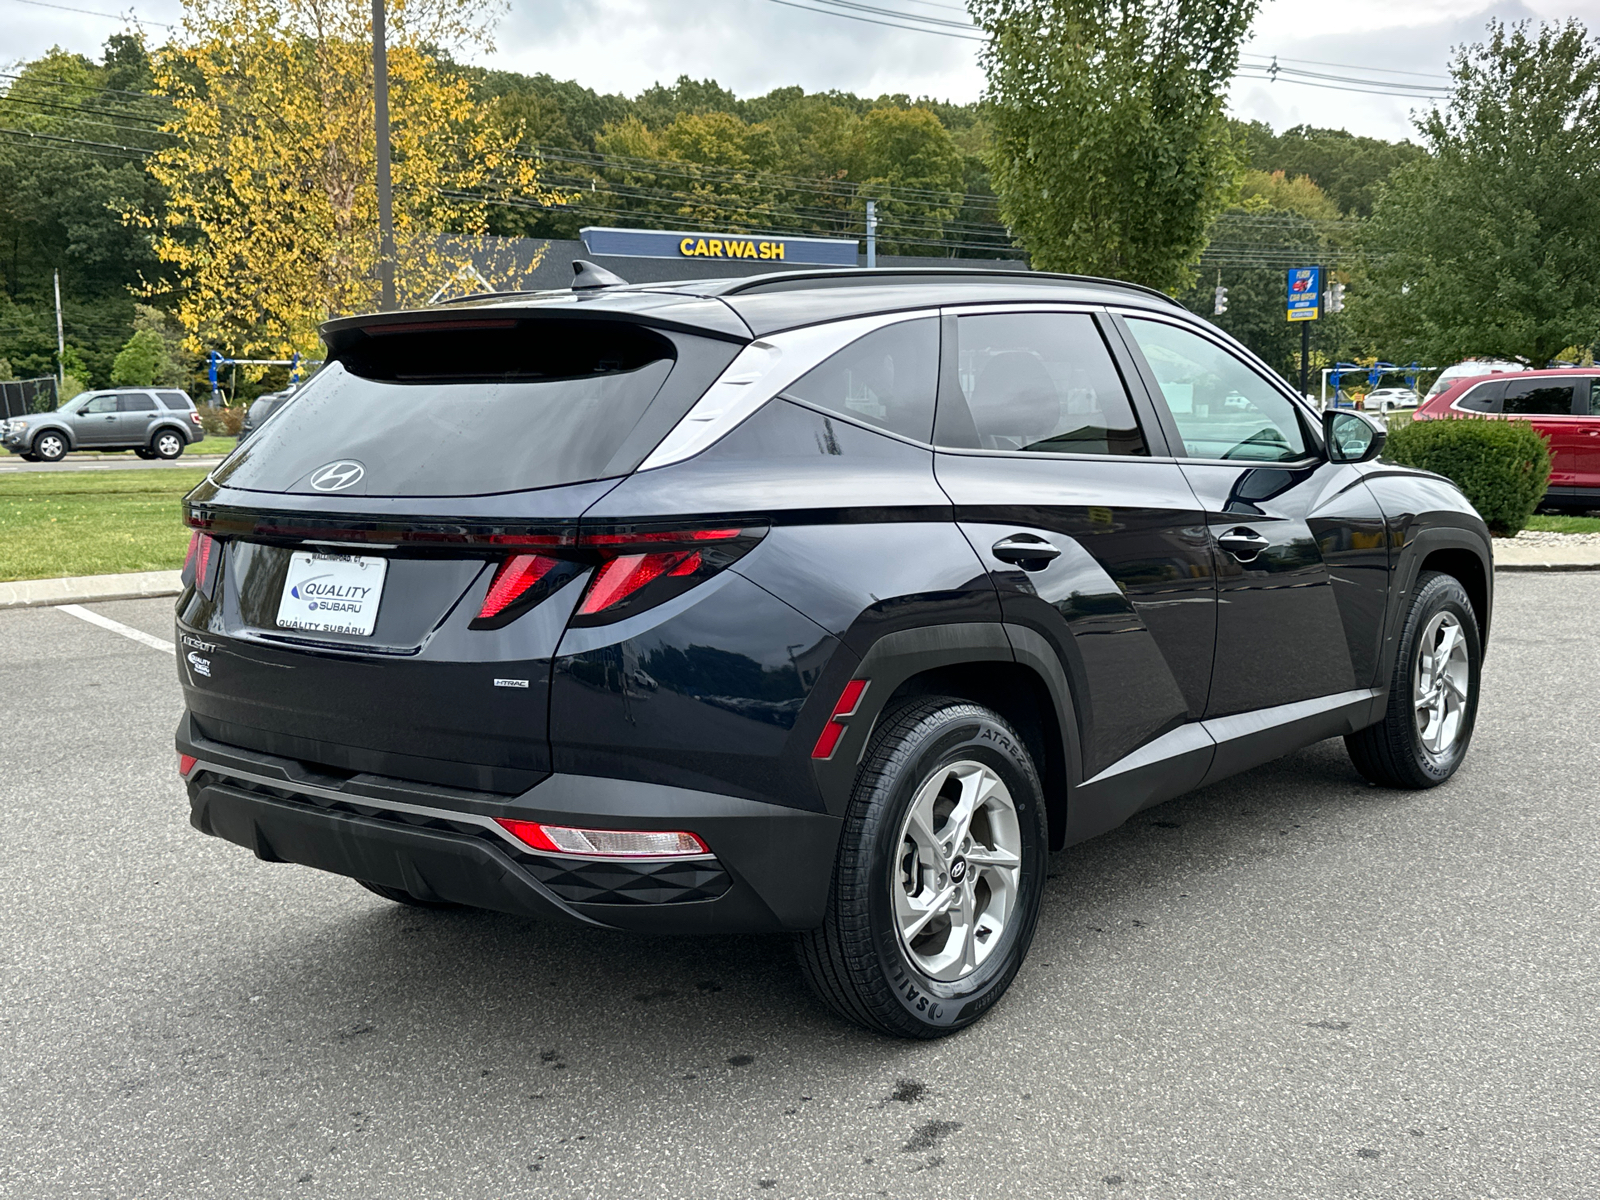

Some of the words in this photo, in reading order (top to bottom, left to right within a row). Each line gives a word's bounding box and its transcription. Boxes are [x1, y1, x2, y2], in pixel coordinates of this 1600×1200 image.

[305, 583, 371, 599] QUALITY
[319, 602, 362, 613] SUBARU
[278, 620, 320, 630] QUALITY
[323, 624, 366, 635] SUBARU
